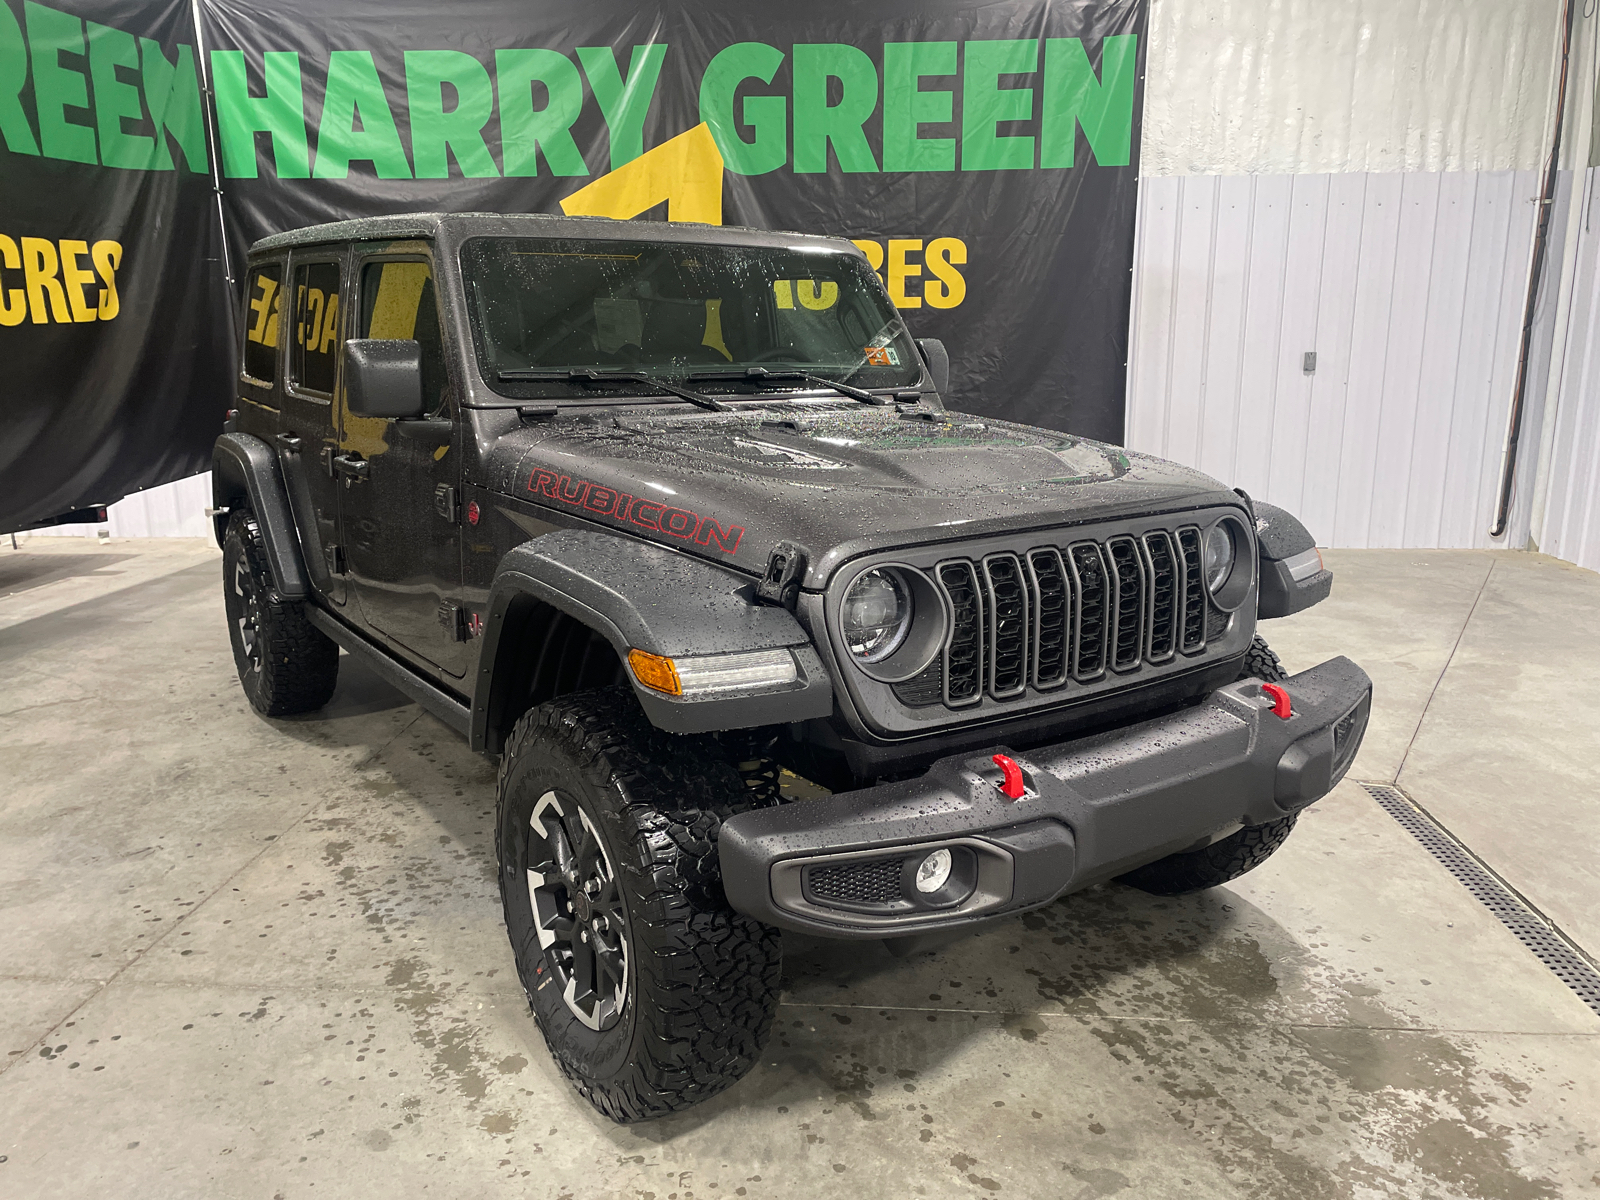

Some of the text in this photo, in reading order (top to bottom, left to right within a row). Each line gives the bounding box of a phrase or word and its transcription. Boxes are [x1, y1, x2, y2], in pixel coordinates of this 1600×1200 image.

[210, 33, 1138, 179] HARRY GREEN
[527, 467, 745, 554] RUBICON
